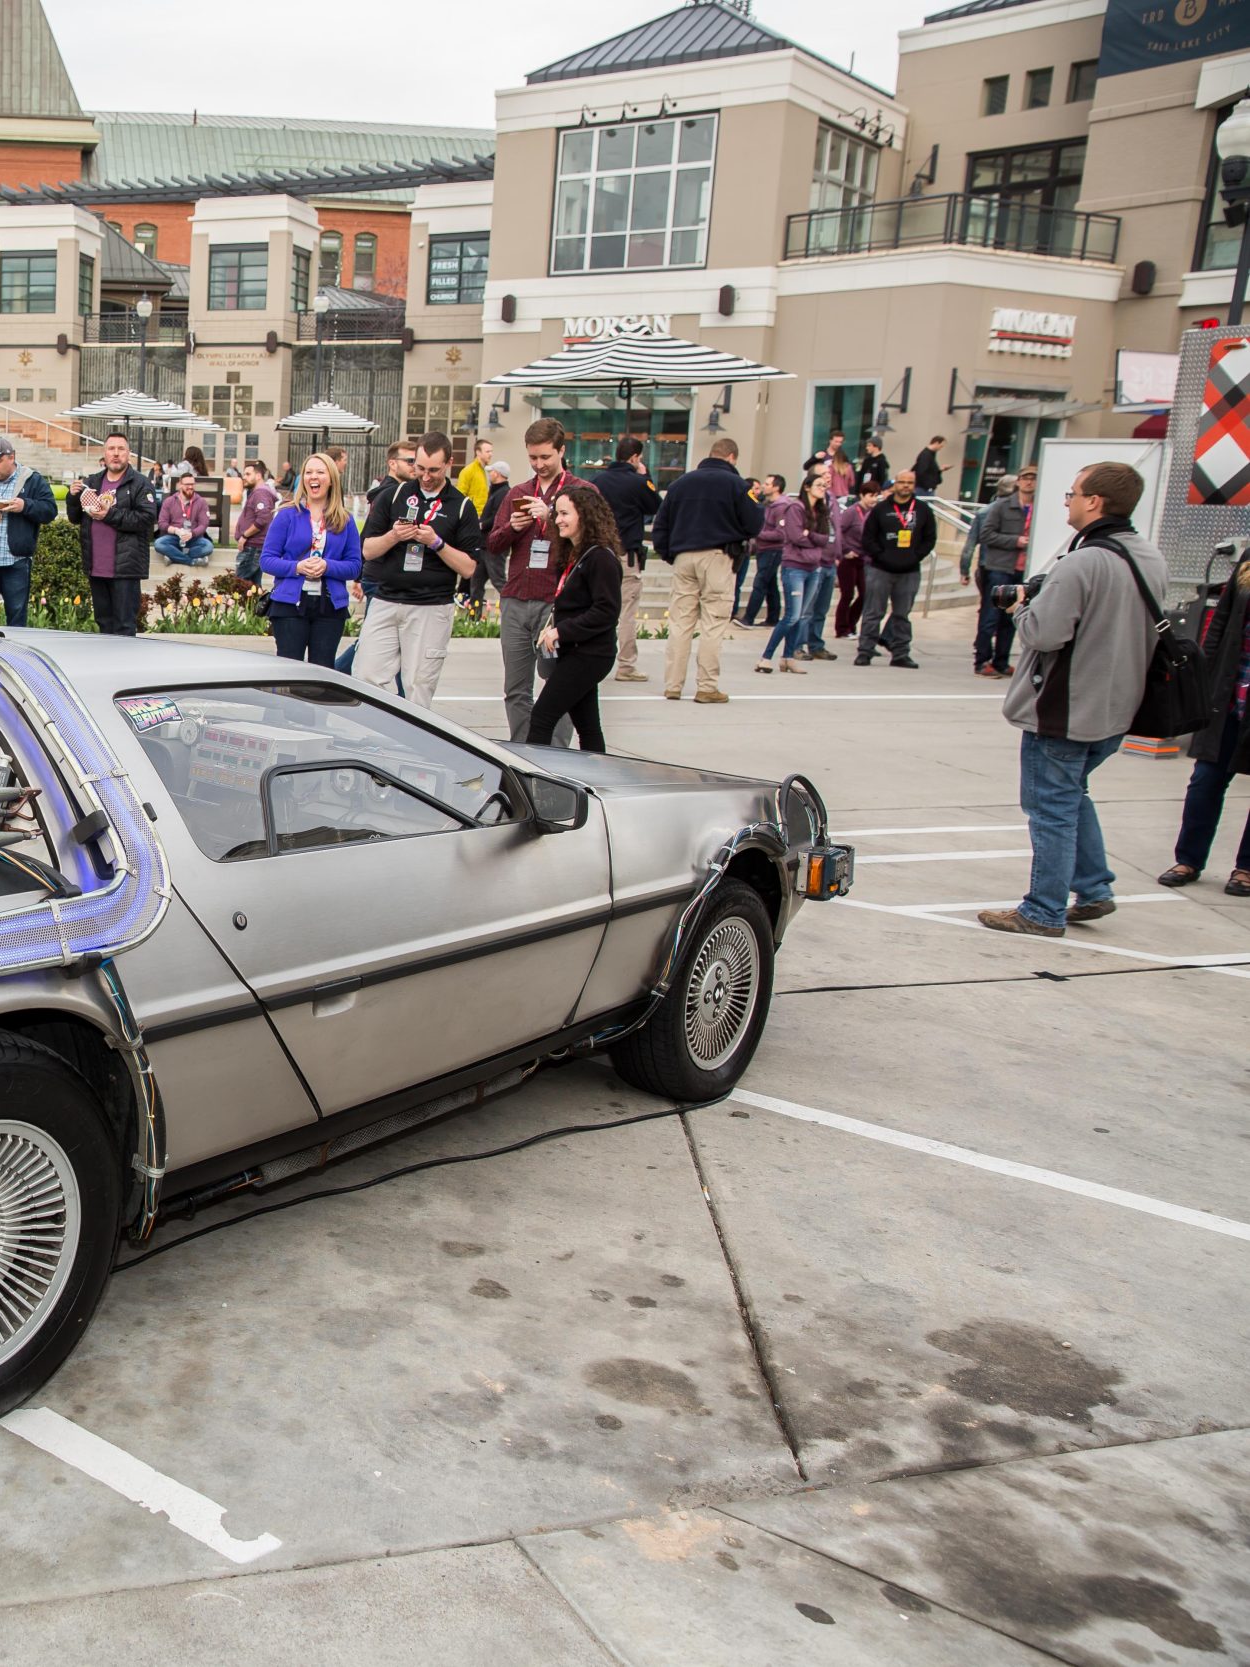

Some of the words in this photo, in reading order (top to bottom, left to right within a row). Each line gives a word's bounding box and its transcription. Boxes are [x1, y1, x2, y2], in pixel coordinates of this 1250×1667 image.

[1206, 24, 1231, 42] CITY
[431, 261, 459, 270] FRESH
[431, 277, 458, 286] FILLED
